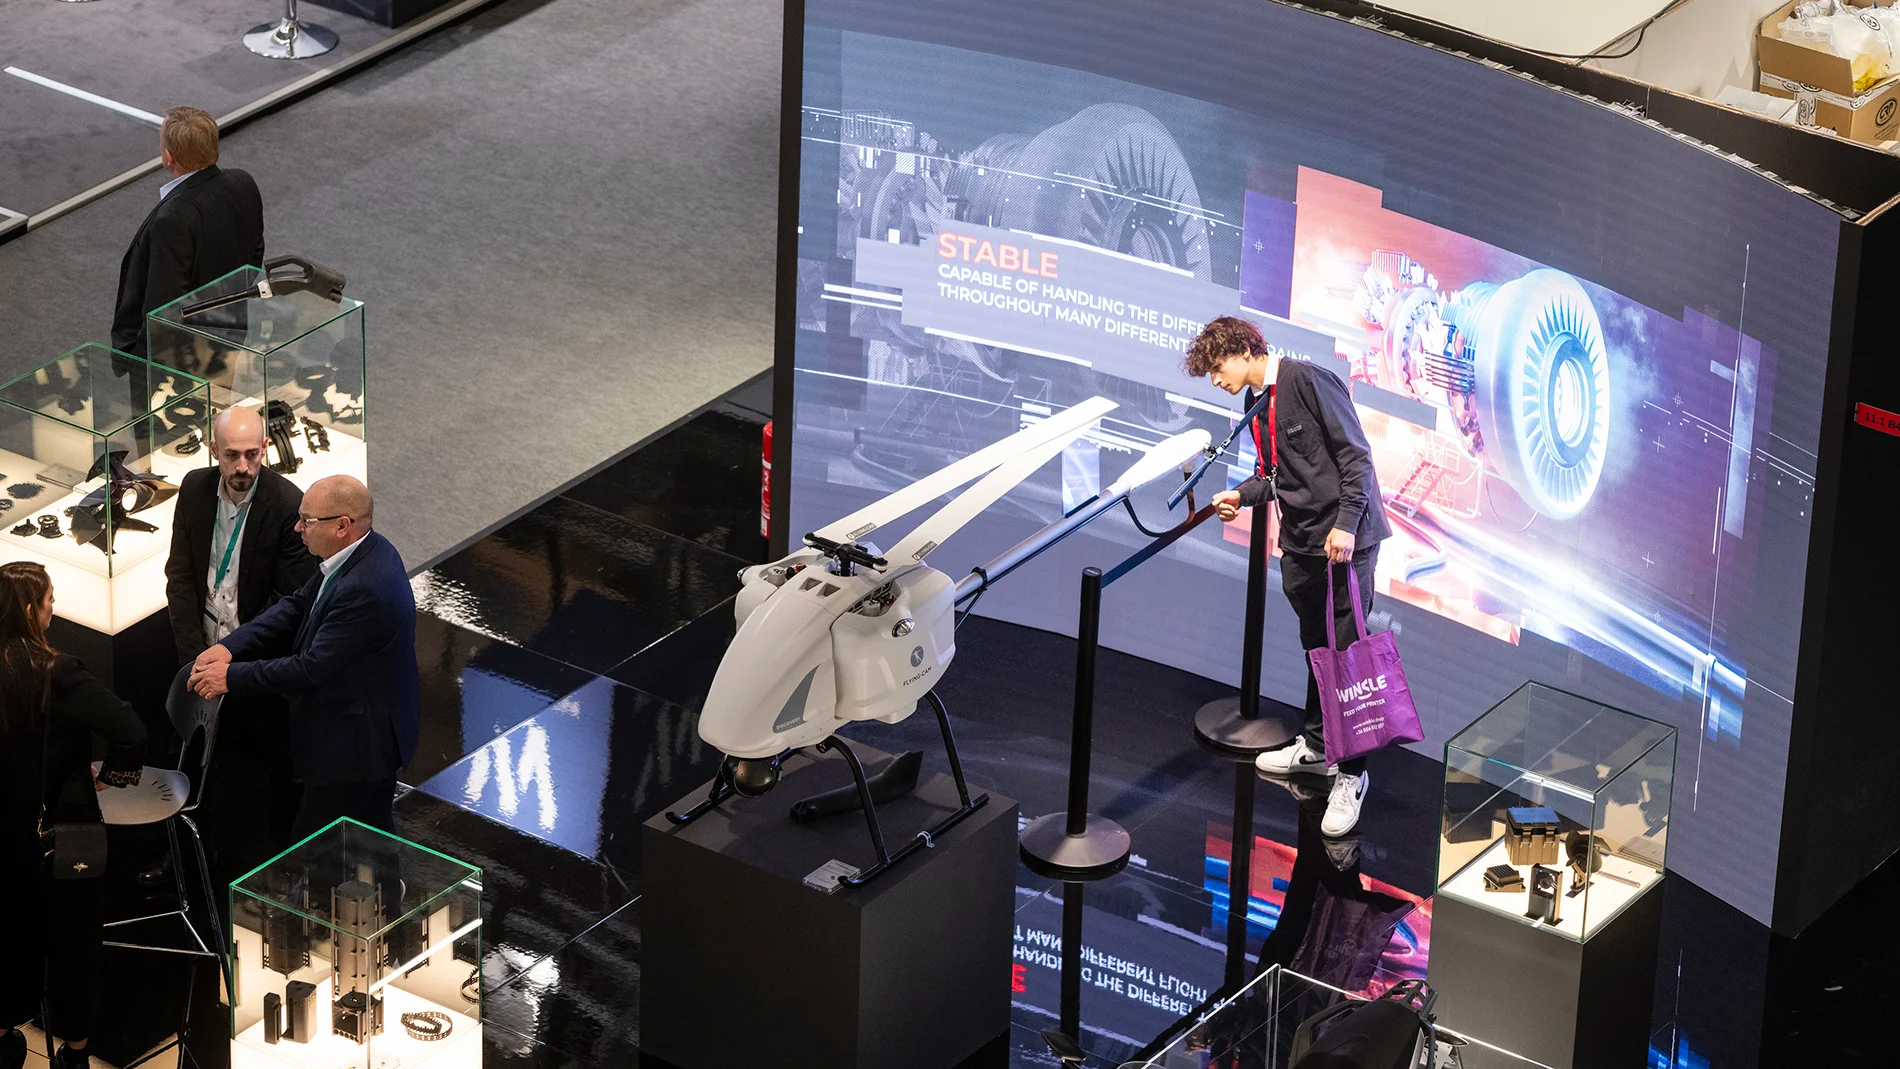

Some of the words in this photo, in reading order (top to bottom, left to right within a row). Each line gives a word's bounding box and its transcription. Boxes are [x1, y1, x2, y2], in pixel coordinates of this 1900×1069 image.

[938, 232, 1059, 279] STABLE
[938, 263, 1012, 291] CAPABLE
[1015, 278, 1039, 295] OF
[1042, 283, 1125, 316] HANDLING
[1128, 303, 1159, 326] THE
[1162, 313, 1206, 336] DIFFE
[937, 281, 1052, 318] THROUGHOUT
[1055, 305, 1102, 329] MANY
[1104, 318, 1190, 353] DIFFERENT
[1865, 412, 1885, 427] 11.1
[903, 666, 932, 687] FLYING-CAM
[1335, 674, 1388, 703] WINSLE
[776, 716, 800, 730] DISCOVERY
